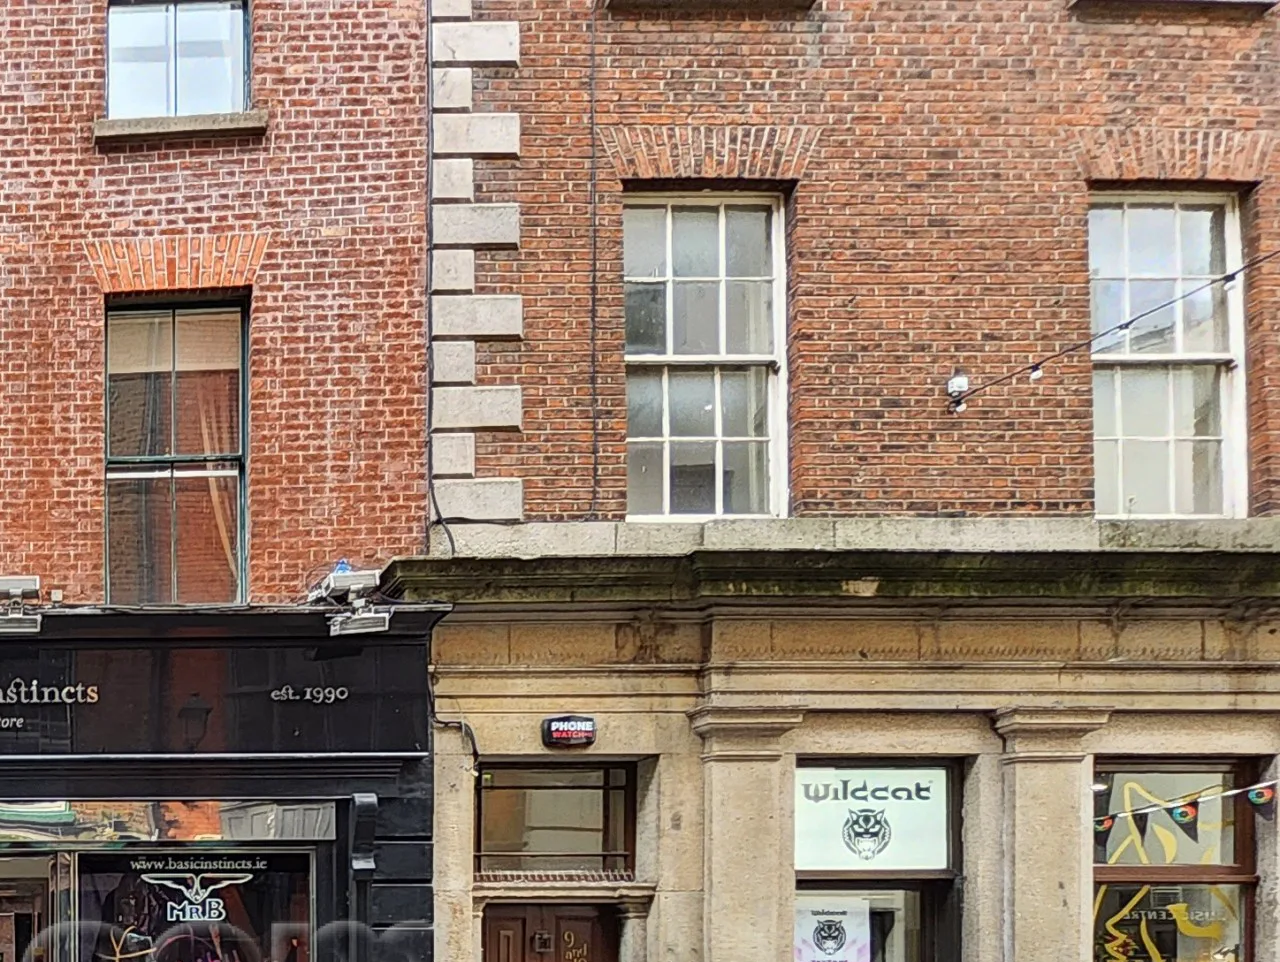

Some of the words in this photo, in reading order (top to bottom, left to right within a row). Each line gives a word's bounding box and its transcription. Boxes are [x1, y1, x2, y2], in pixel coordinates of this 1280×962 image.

[270, 685, 300, 701] est.
[304, 687, 349, 703] 1990
[551, 721, 593, 731] PHONE
[130, 857, 267, 870] www.basicinstincts.ie
[564, 931, 574, 947] 9
